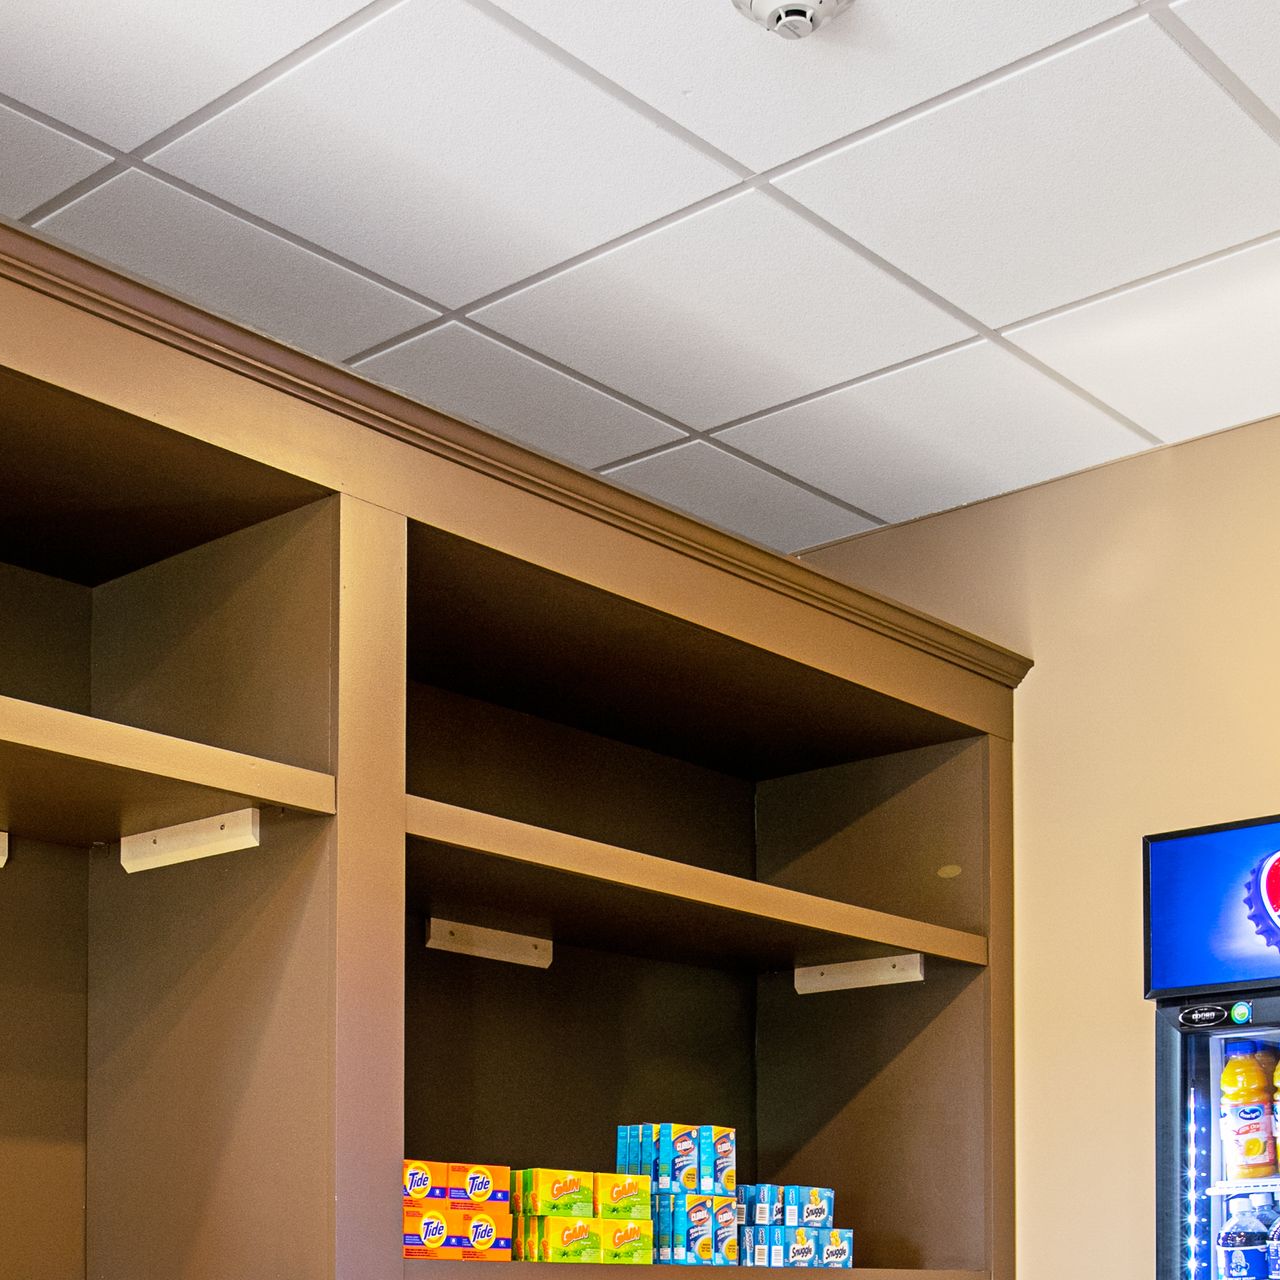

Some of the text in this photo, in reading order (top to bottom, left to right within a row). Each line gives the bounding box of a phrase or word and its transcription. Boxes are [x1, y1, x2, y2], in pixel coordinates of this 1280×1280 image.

[409, 1172, 429, 1191] Tide
[469, 1176, 490, 1195] Tide
[806, 1207, 826, 1218] Snuggle
[423, 1221, 444, 1240] Tide
[472, 1224, 493, 1243] Tide
[791, 1246, 812, 1258] Snuggle
[826, 1246, 846, 1259] Snuggle
